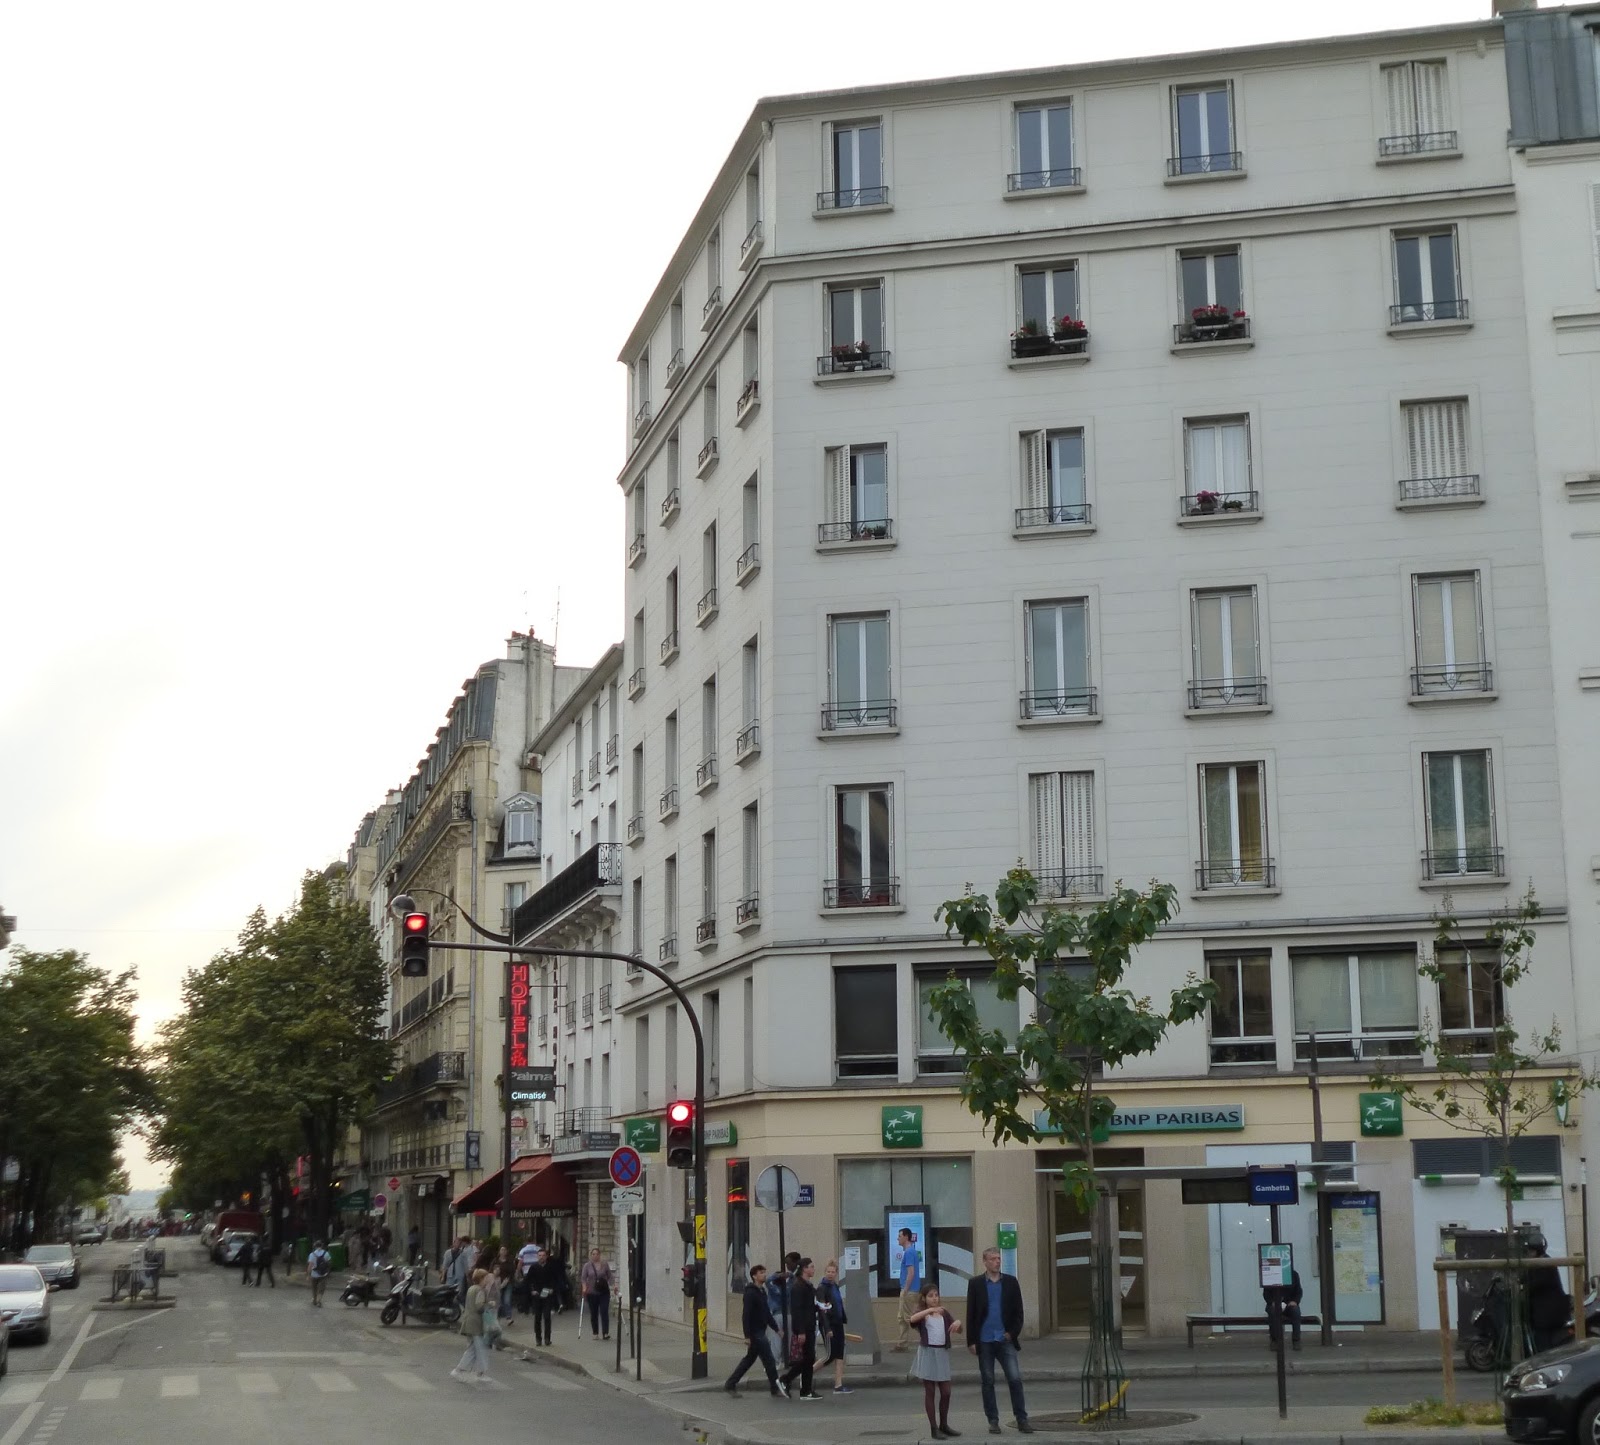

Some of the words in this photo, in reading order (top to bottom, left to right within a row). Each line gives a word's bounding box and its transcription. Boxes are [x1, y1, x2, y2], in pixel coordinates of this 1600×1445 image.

[511, 965, 528, 1049] HOTEL
[511, 1091, 547, 1100] Climatisé
[1110, 1113, 1151, 1126] BNP
[1156, 1111, 1240, 1125] PARIBAS
[1255, 1184, 1290, 1192] Gambetta
[510, 1209, 541, 1218] Houblon
[541, 1208, 551, 1217] du
[1270, 1249, 1291, 1260] BUS
